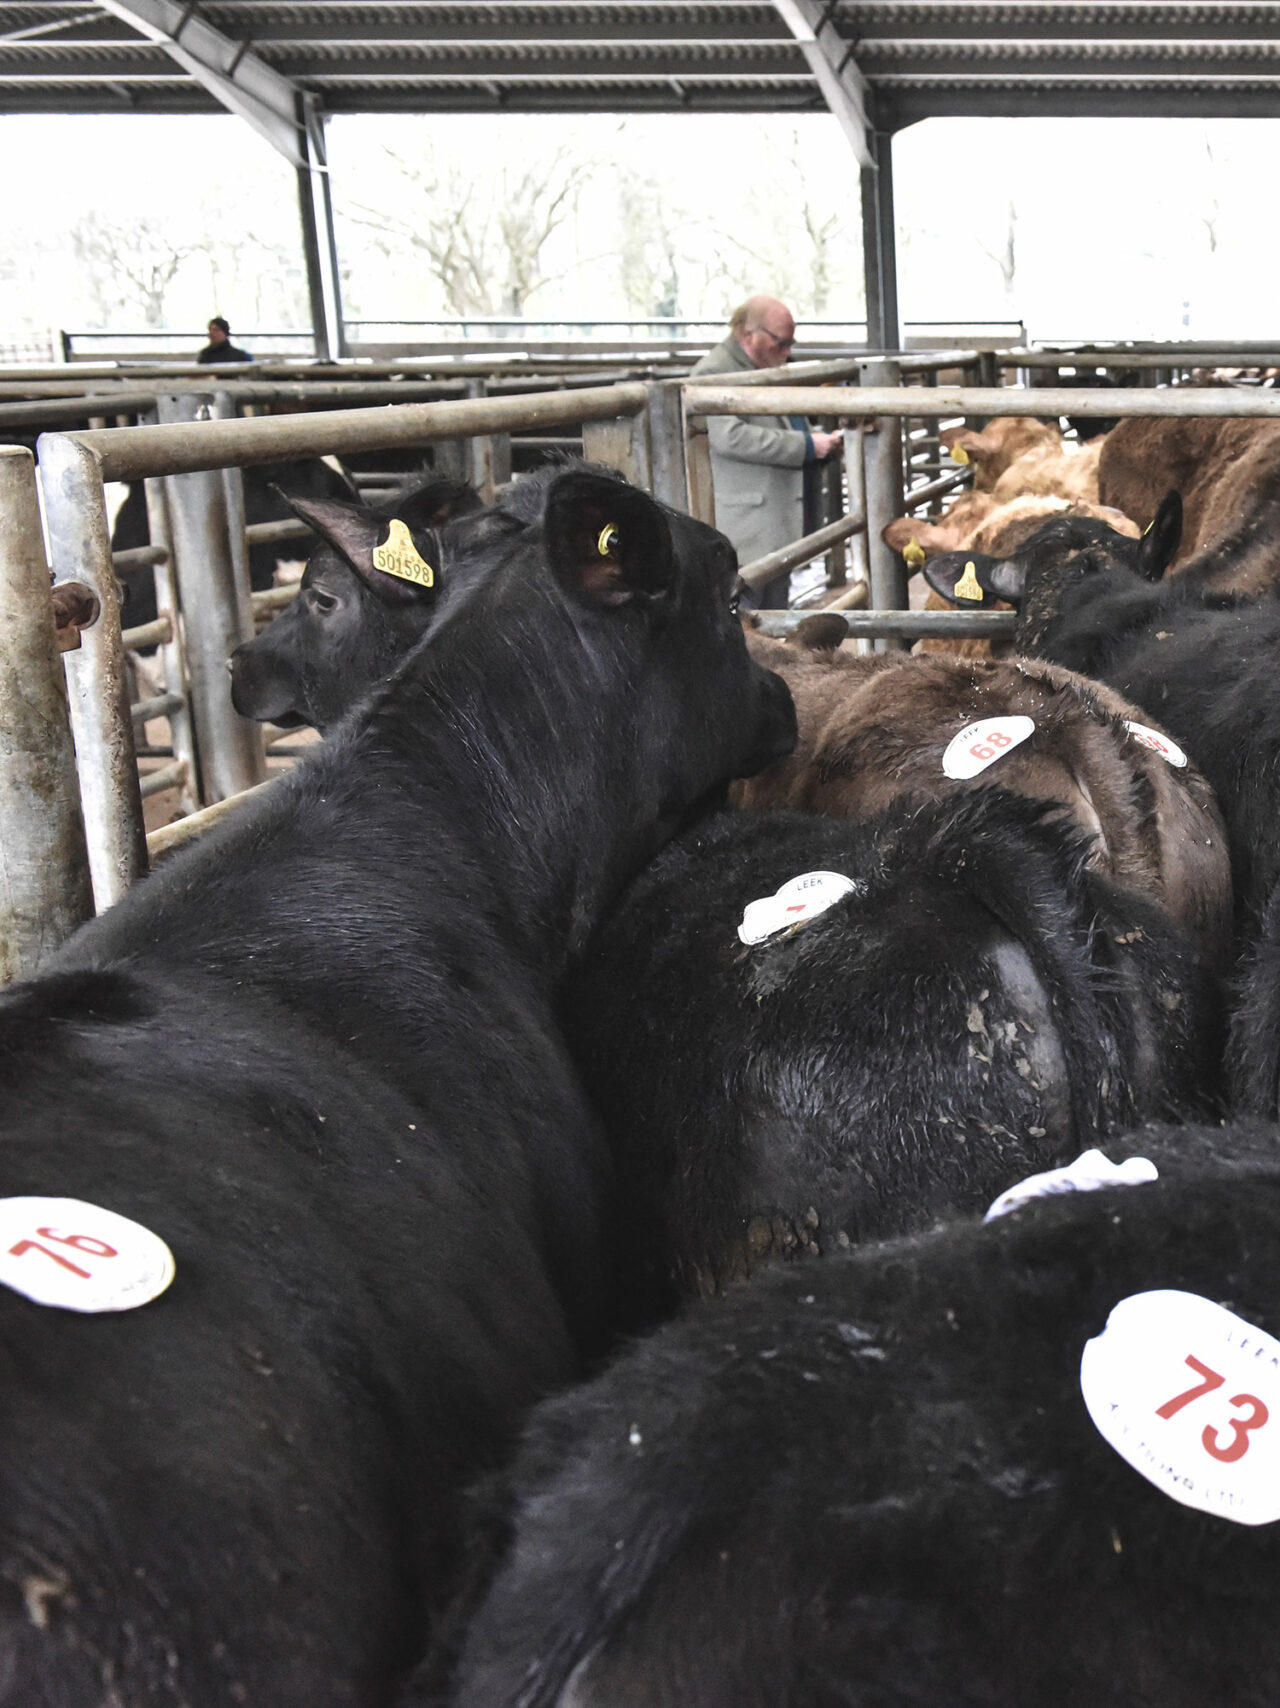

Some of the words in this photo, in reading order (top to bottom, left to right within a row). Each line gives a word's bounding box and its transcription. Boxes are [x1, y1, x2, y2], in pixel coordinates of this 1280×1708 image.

[378, 550, 430, 583] 501598
[969, 732, 1013, 760] 68
[8, 1227, 119, 1279] 76
[1155, 1354, 1269, 1463] 73
